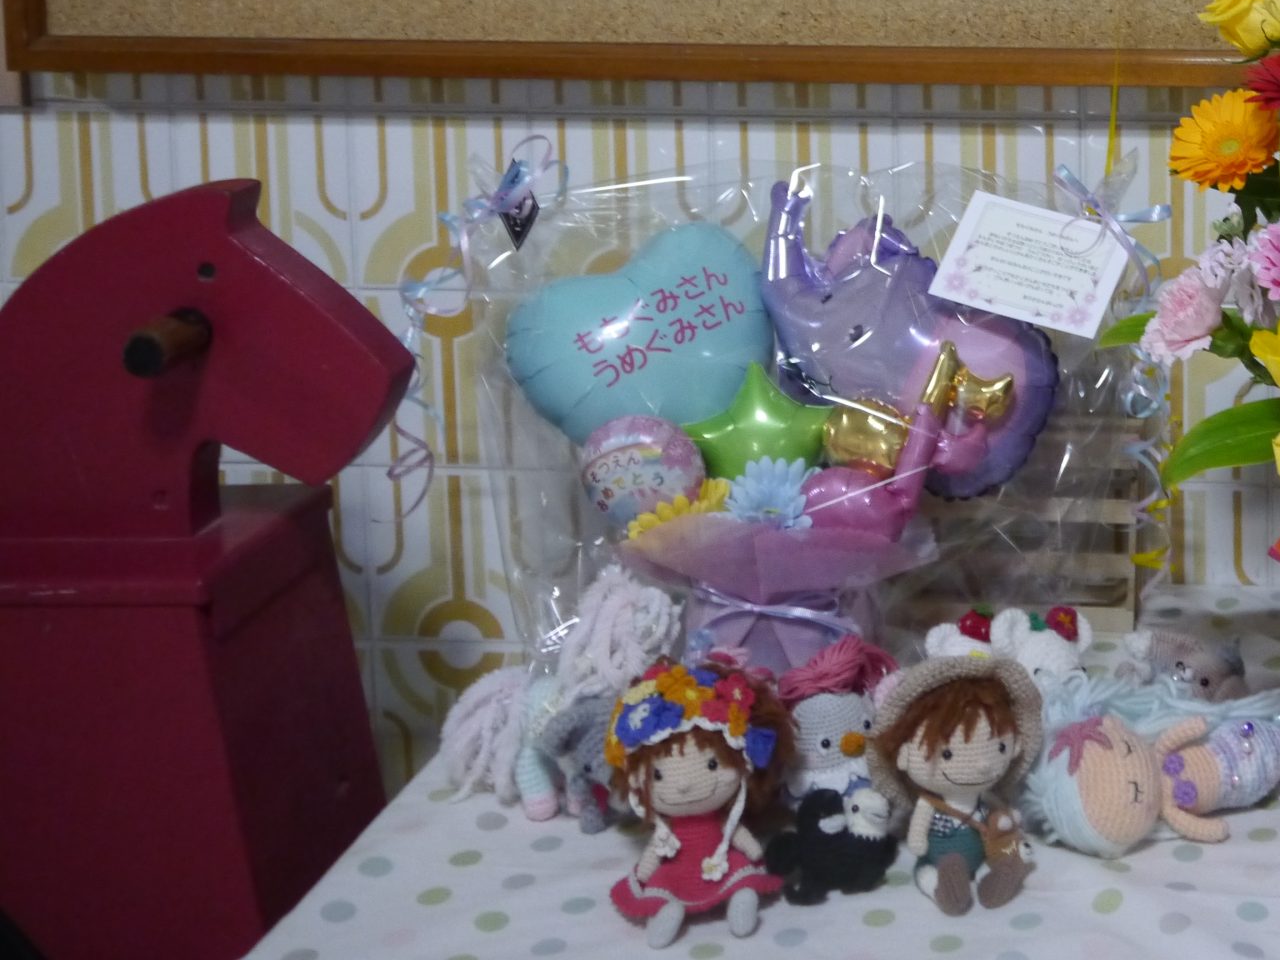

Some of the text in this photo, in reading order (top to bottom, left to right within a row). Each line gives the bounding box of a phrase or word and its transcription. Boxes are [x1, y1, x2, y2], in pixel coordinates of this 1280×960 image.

[592, 295, 746, 388] うめぐみさん
